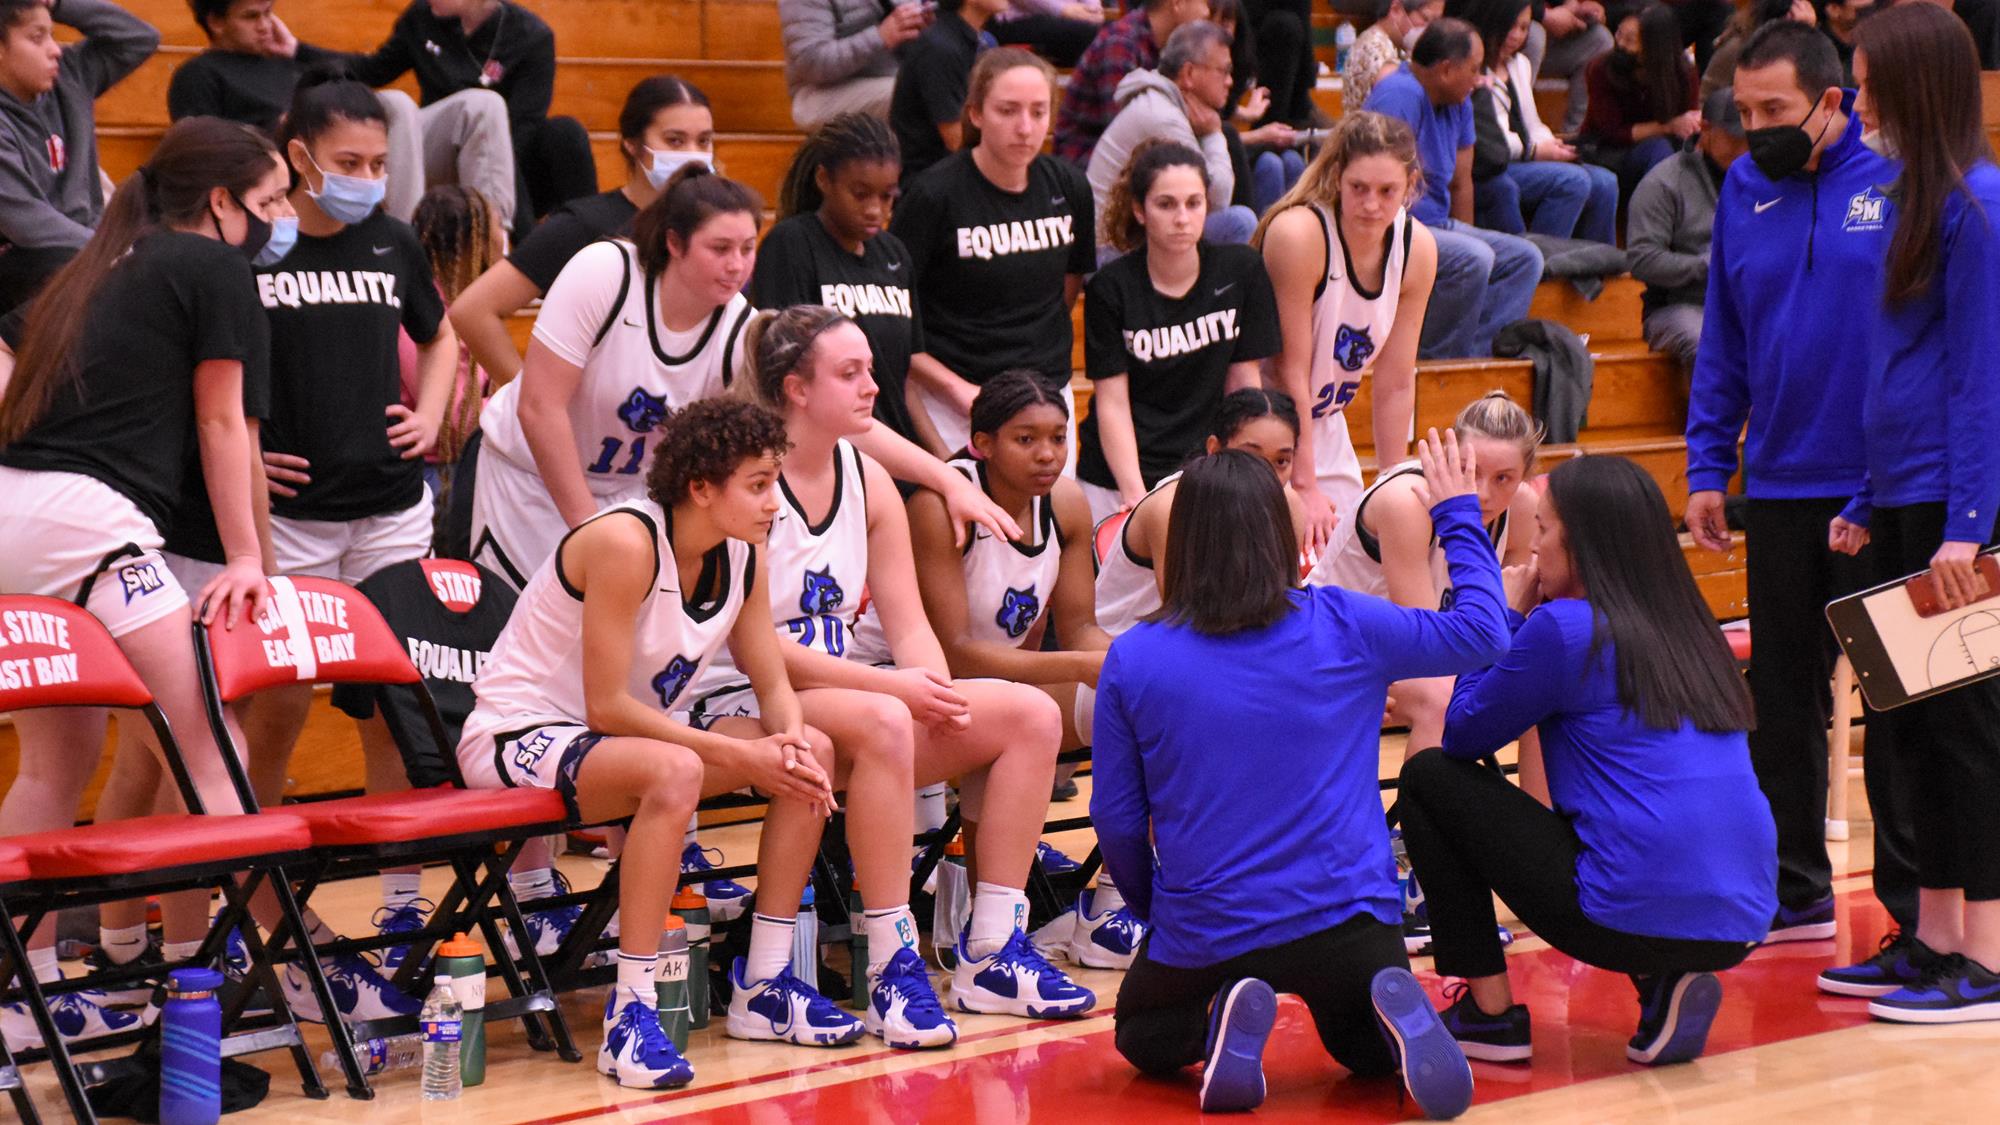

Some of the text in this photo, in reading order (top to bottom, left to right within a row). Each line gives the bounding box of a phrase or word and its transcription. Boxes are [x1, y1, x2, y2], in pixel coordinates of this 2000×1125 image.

[1845, 189, 1885, 225] SM
[957, 215, 1075, 260] EQUALITY.
[256, 271, 401, 308] EQUALITY.
[587, 436, 646, 474] 11
[118, 564, 164, 603] SM
[297, 591, 349, 630] TATE
[3, 610, 71, 650] STATE
[314, 633, 356, 663] BAY
[33, 653, 79, 686] BAY
